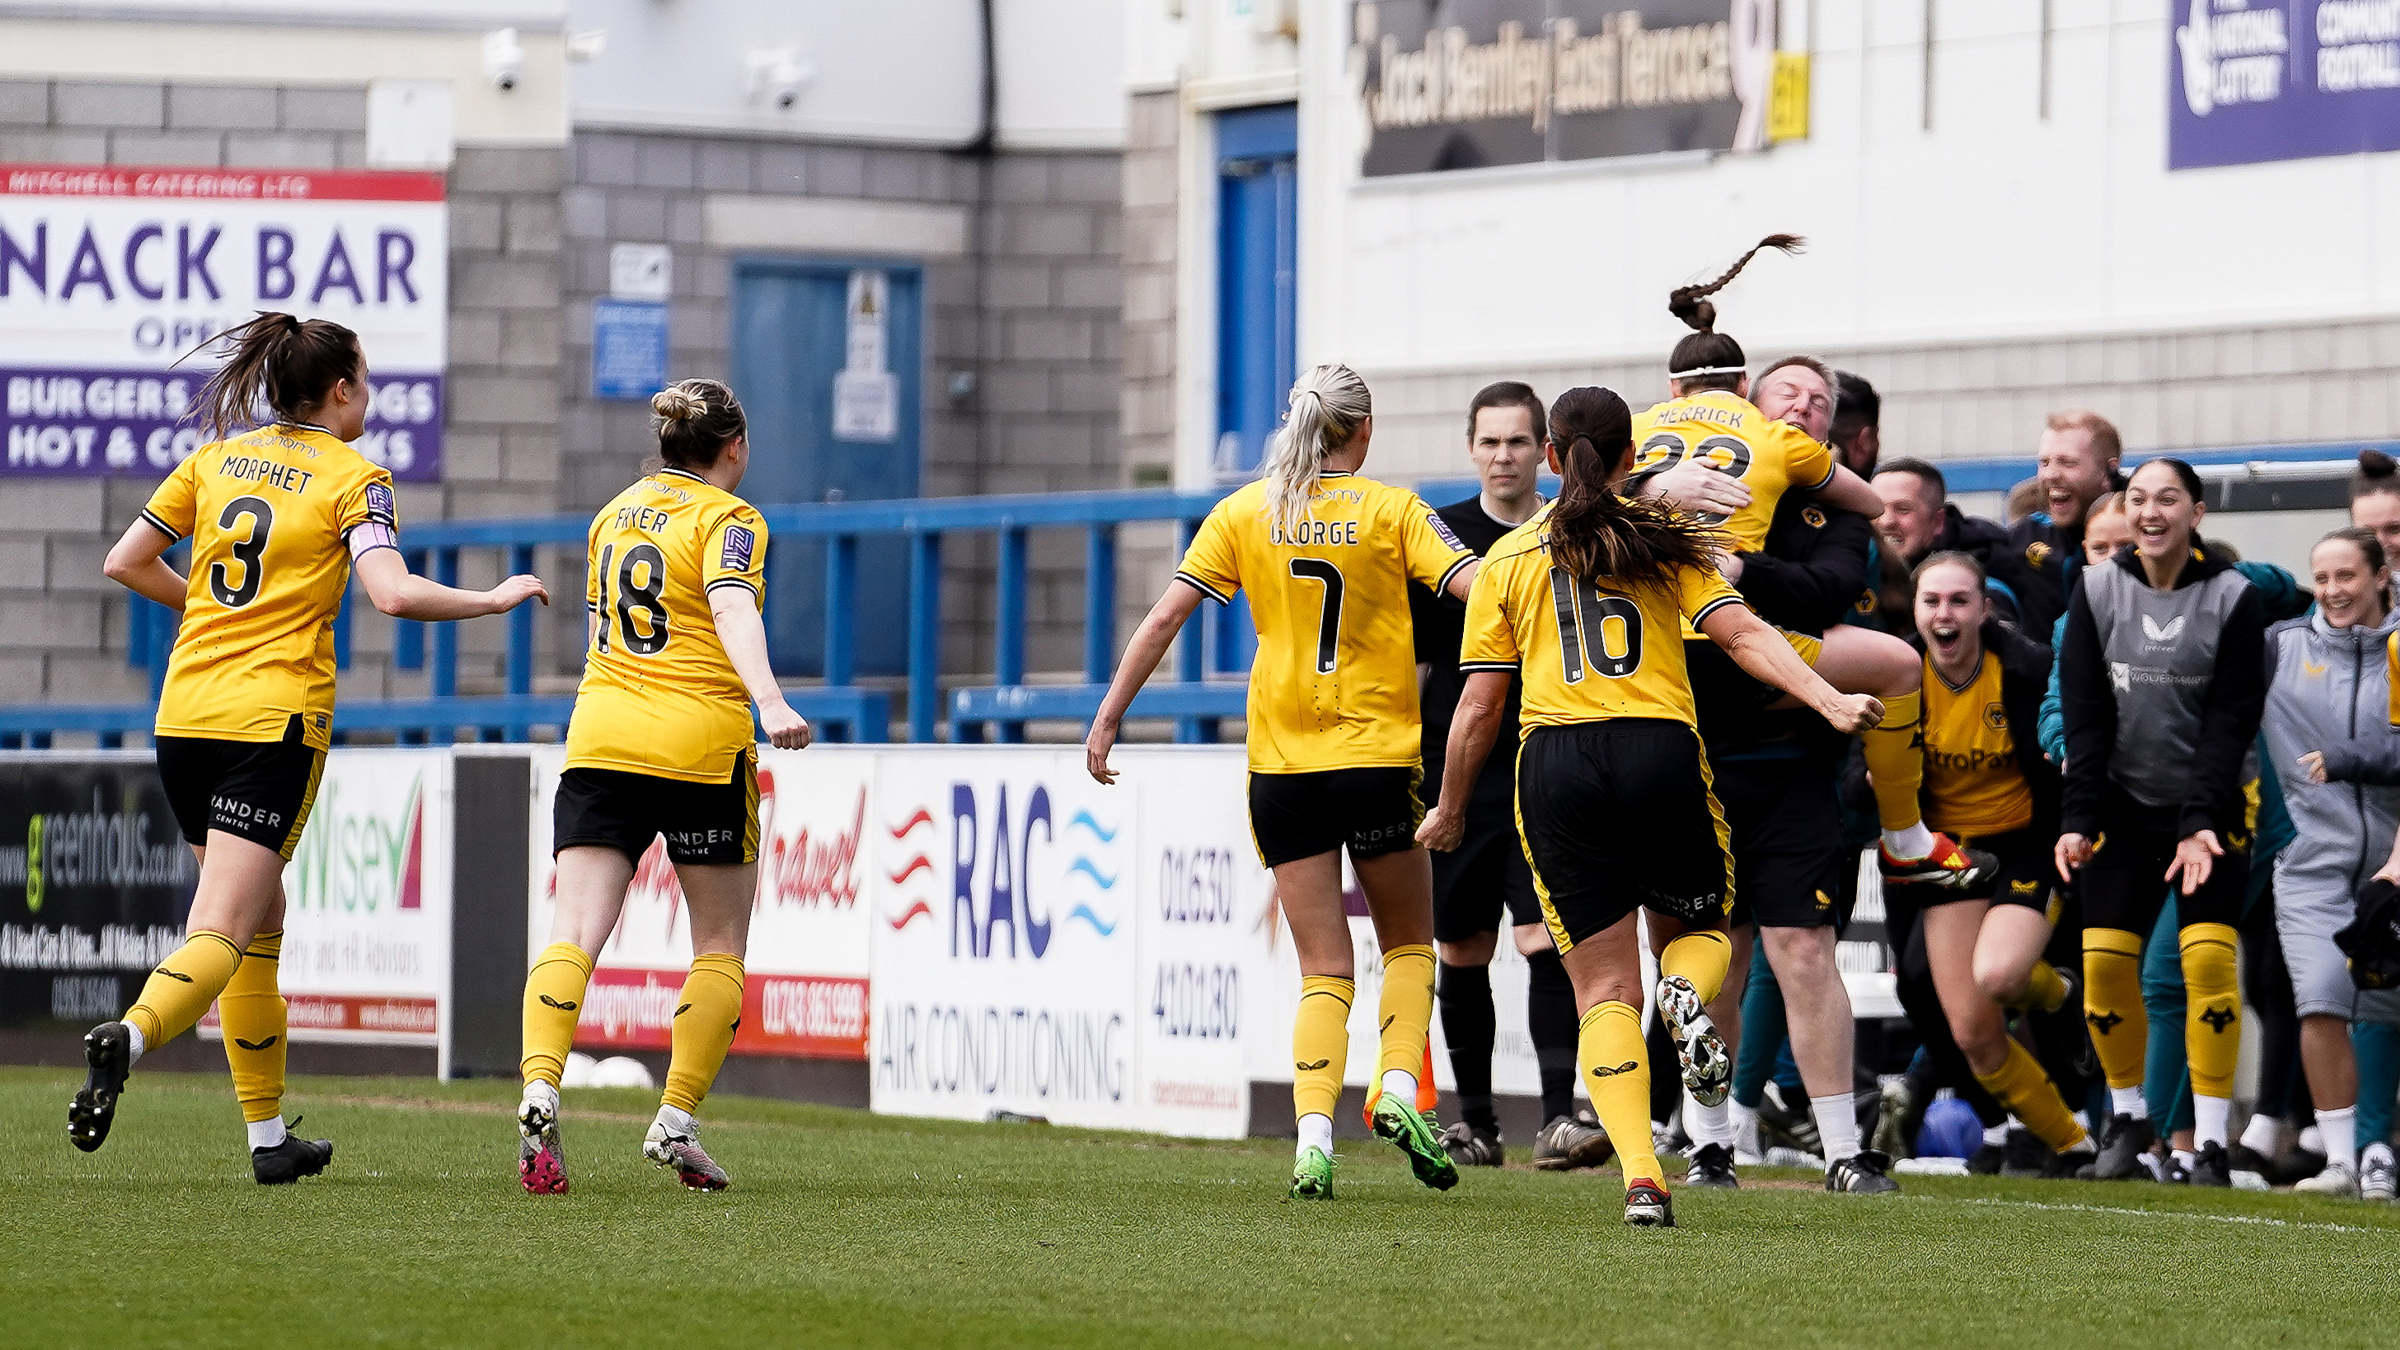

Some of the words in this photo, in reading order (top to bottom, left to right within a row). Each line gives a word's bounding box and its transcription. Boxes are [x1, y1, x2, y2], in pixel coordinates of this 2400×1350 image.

[1443, 20, 1548, 133] Bentley
[8, 170, 128, 195] MITCHELL
[135, 173, 257, 196] CATERING
[262, 174, 313, 197] LTD
[256, 224, 419, 304] BAR
[7, 376, 189, 419] BURGERS
[1653, 406, 1743, 429] MERRICK
[8, 425, 97, 468] HOT
[105, 426, 138, 469] &
[219, 455, 312, 495] MORPHET
[210, 494, 274, 609] 3
[614, 506, 668, 533] FRYER
[598, 543, 670, 655] 18
[1288, 557, 1345, 674] 7
[1548, 565, 1643, 685] 16
[216, 813, 249, 831] CENTRE
[951, 780, 1051, 960] RAC
[1159, 848, 1231, 924] 01630
[1151, 961, 1237, 1040] 410180
[877, 1003, 917, 1091] AIR
[926, 1003, 1122, 1101] CONDITIONING
